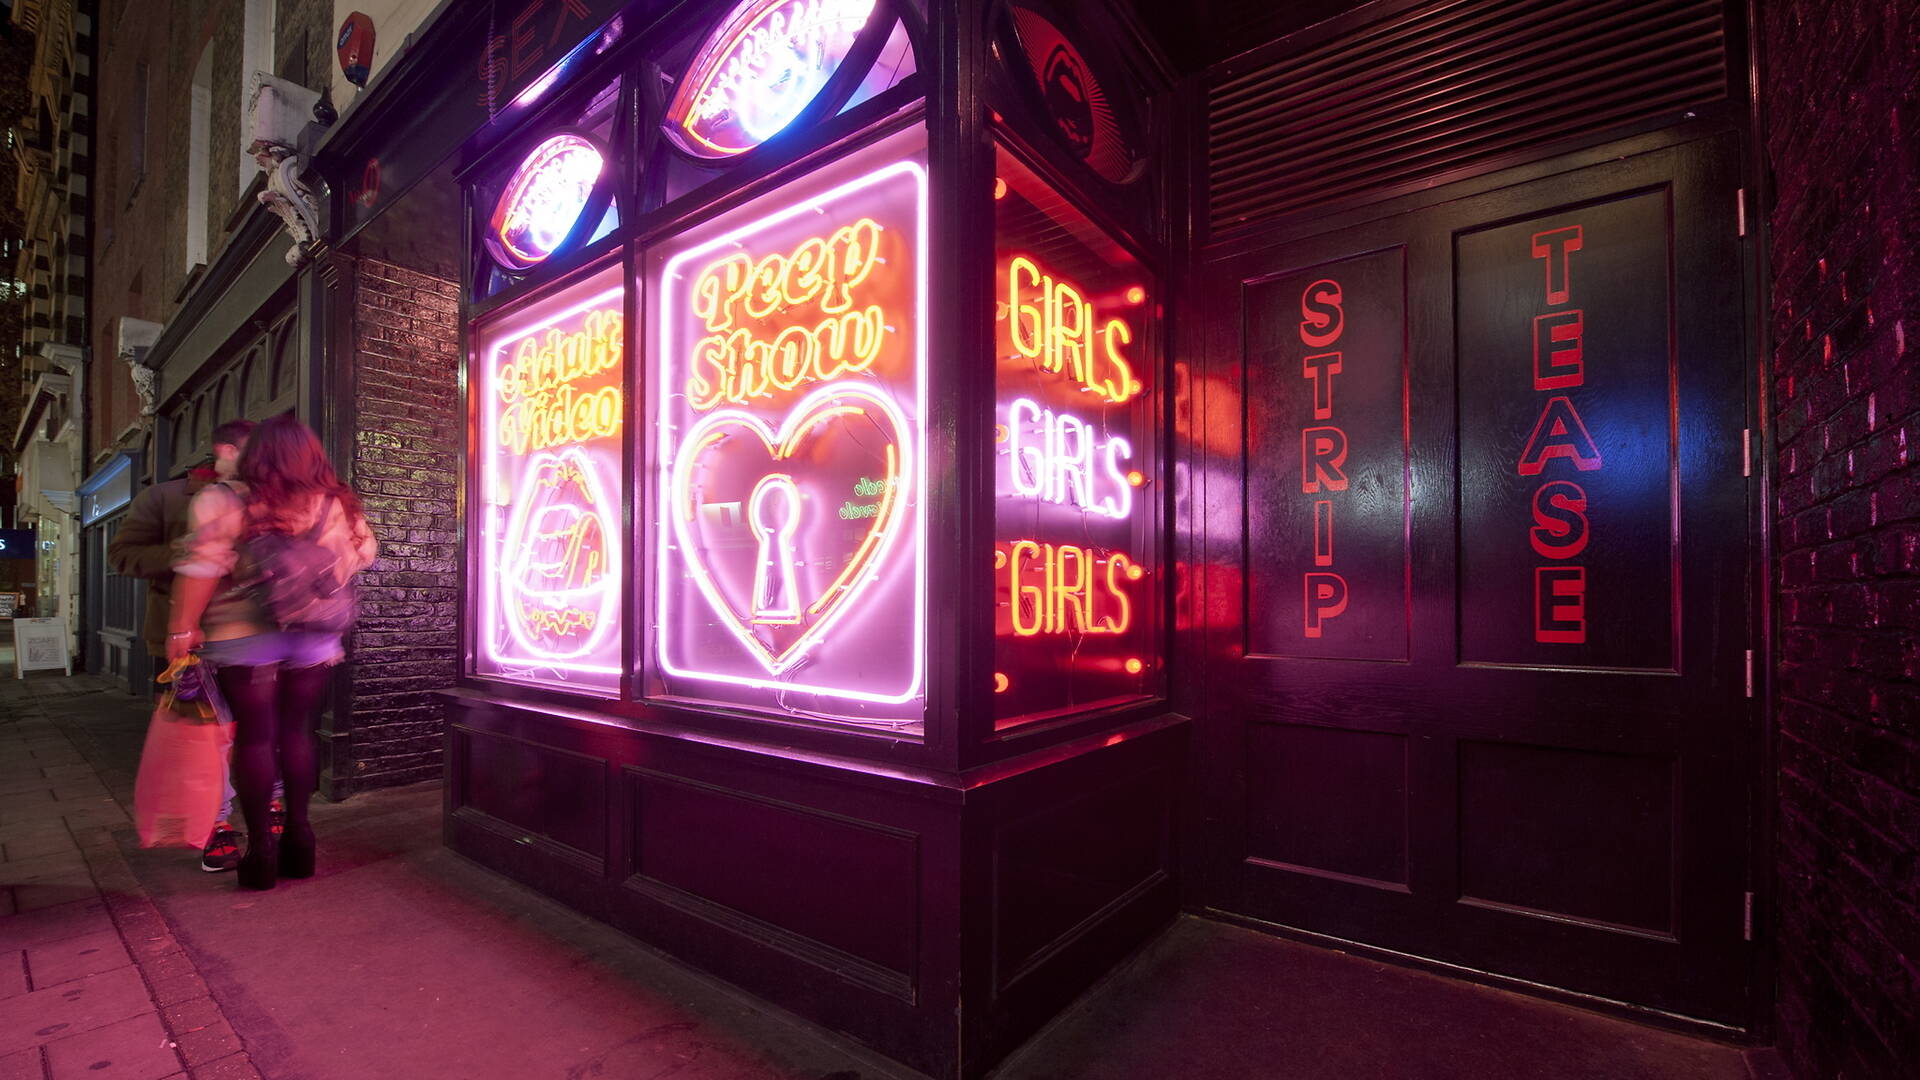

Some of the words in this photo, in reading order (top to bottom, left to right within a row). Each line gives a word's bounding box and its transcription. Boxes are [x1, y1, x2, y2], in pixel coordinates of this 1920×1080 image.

[692, 218, 879, 332] Peep
[1010, 257, 1131, 402] GIRLS
[500, 309, 622, 404] Adult
[686, 304, 885, 411] Show
[500, 385, 623, 456] Video
[1010, 398, 1132, 519] GIRLS
[1299, 279, 1349, 638] STRIP
[1518, 224, 1602, 644] TEASE
[1011, 540, 1130, 635] GIRLS
